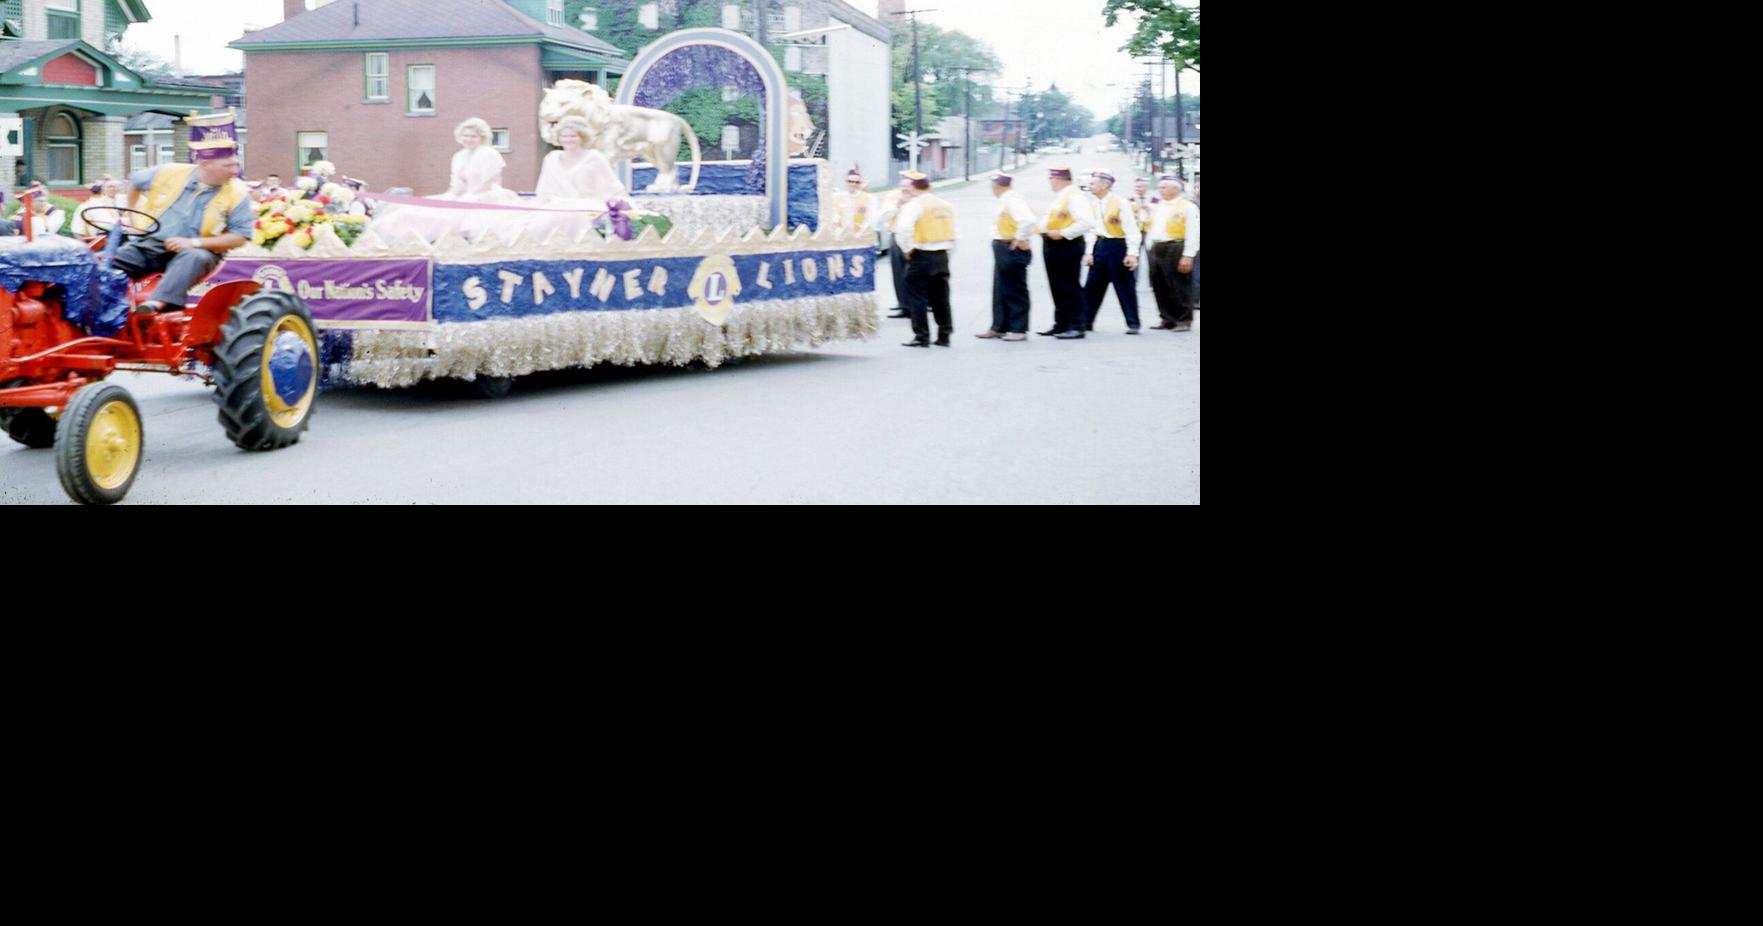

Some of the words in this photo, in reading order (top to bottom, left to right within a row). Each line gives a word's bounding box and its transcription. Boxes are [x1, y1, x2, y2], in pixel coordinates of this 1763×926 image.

[297, 279, 324, 300] Our
[375, 279, 425, 303] Safety
[462, 265, 668, 310] STAYNER
[756, 254, 865, 289] LIONS
[708, 274, 725, 301] L
